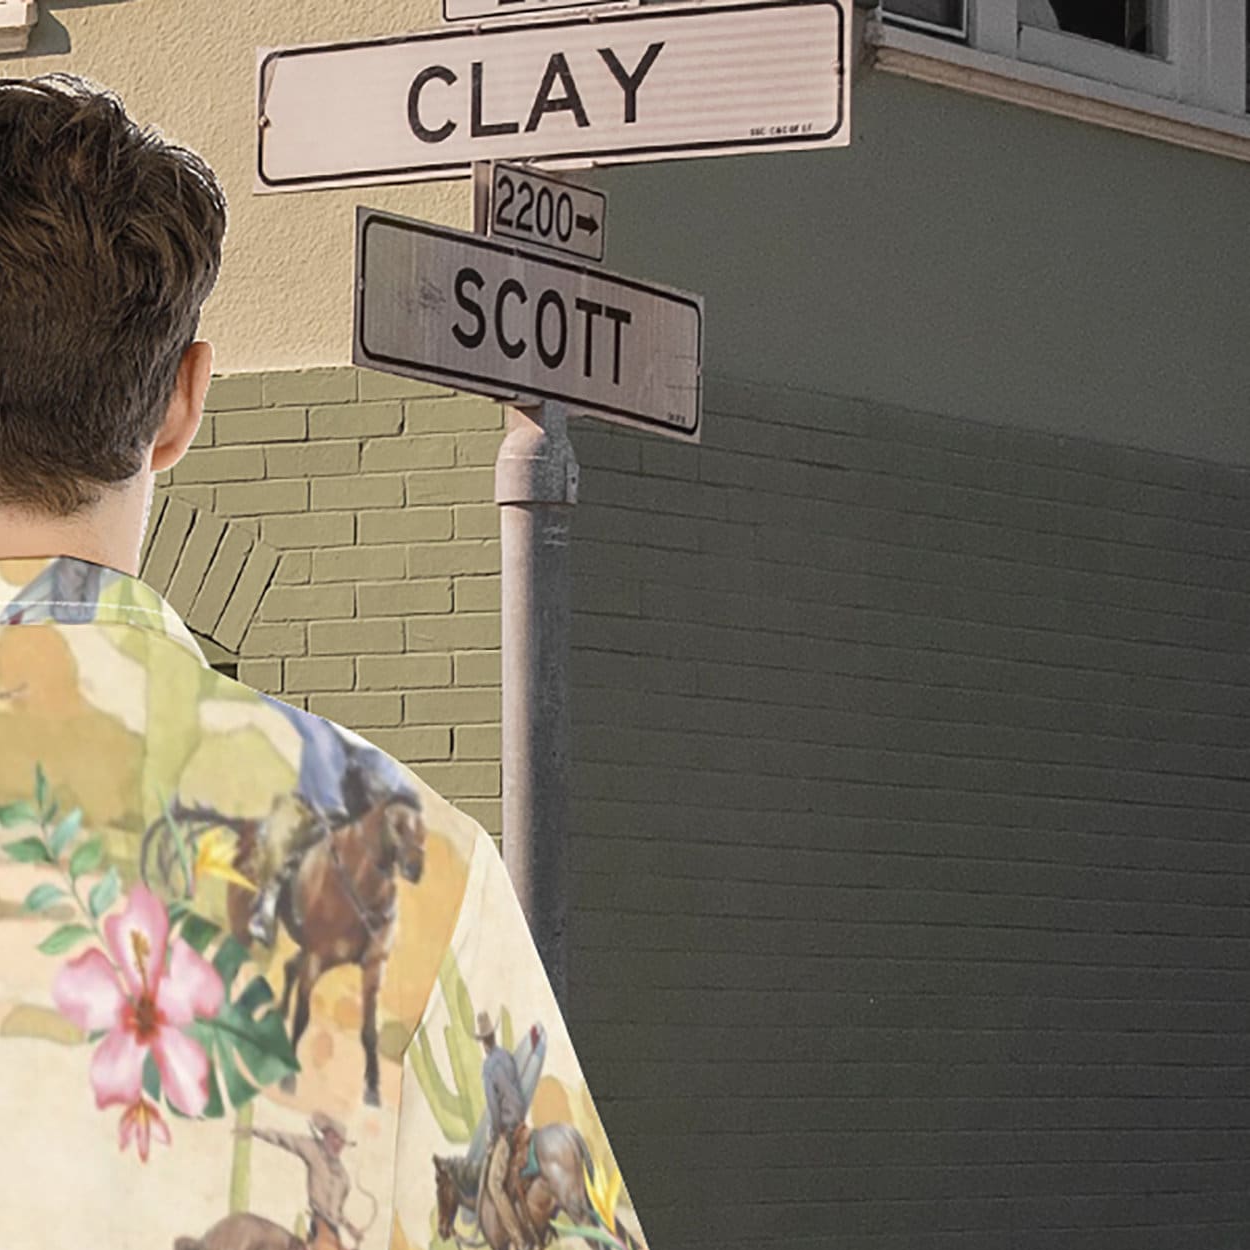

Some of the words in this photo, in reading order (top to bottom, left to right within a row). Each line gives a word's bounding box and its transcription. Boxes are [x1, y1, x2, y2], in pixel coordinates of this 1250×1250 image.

[407, 41, 665, 143] CLAY
[496, 175, 573, 242] 2200
[451, 267, 631, 385] SCOTT
